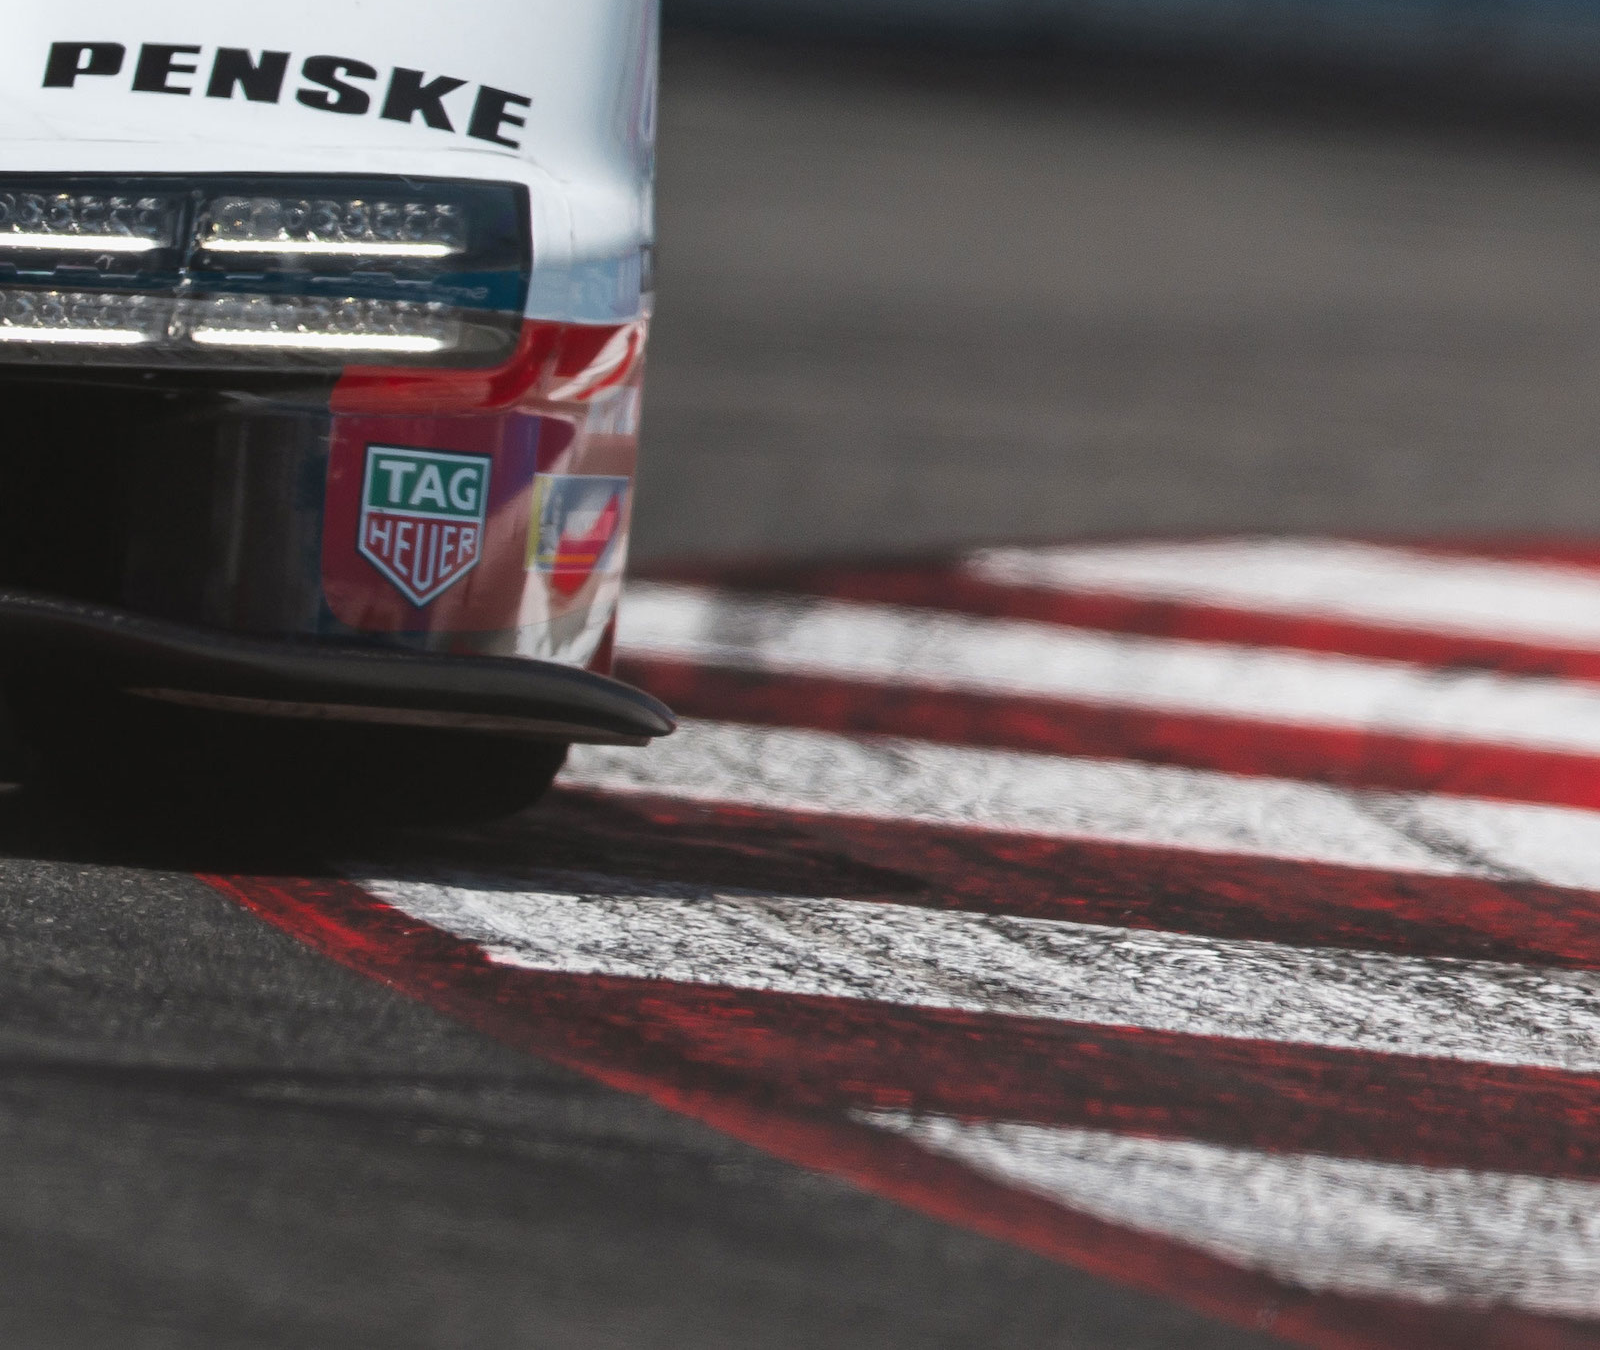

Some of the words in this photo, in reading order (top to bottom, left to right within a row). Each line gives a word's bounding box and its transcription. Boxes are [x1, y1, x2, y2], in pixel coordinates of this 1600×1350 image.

[40, 39, 534, 151] PENSKE
[378, 459, 479, 512] TAG
[369, 519, 477, 592] HEUER
